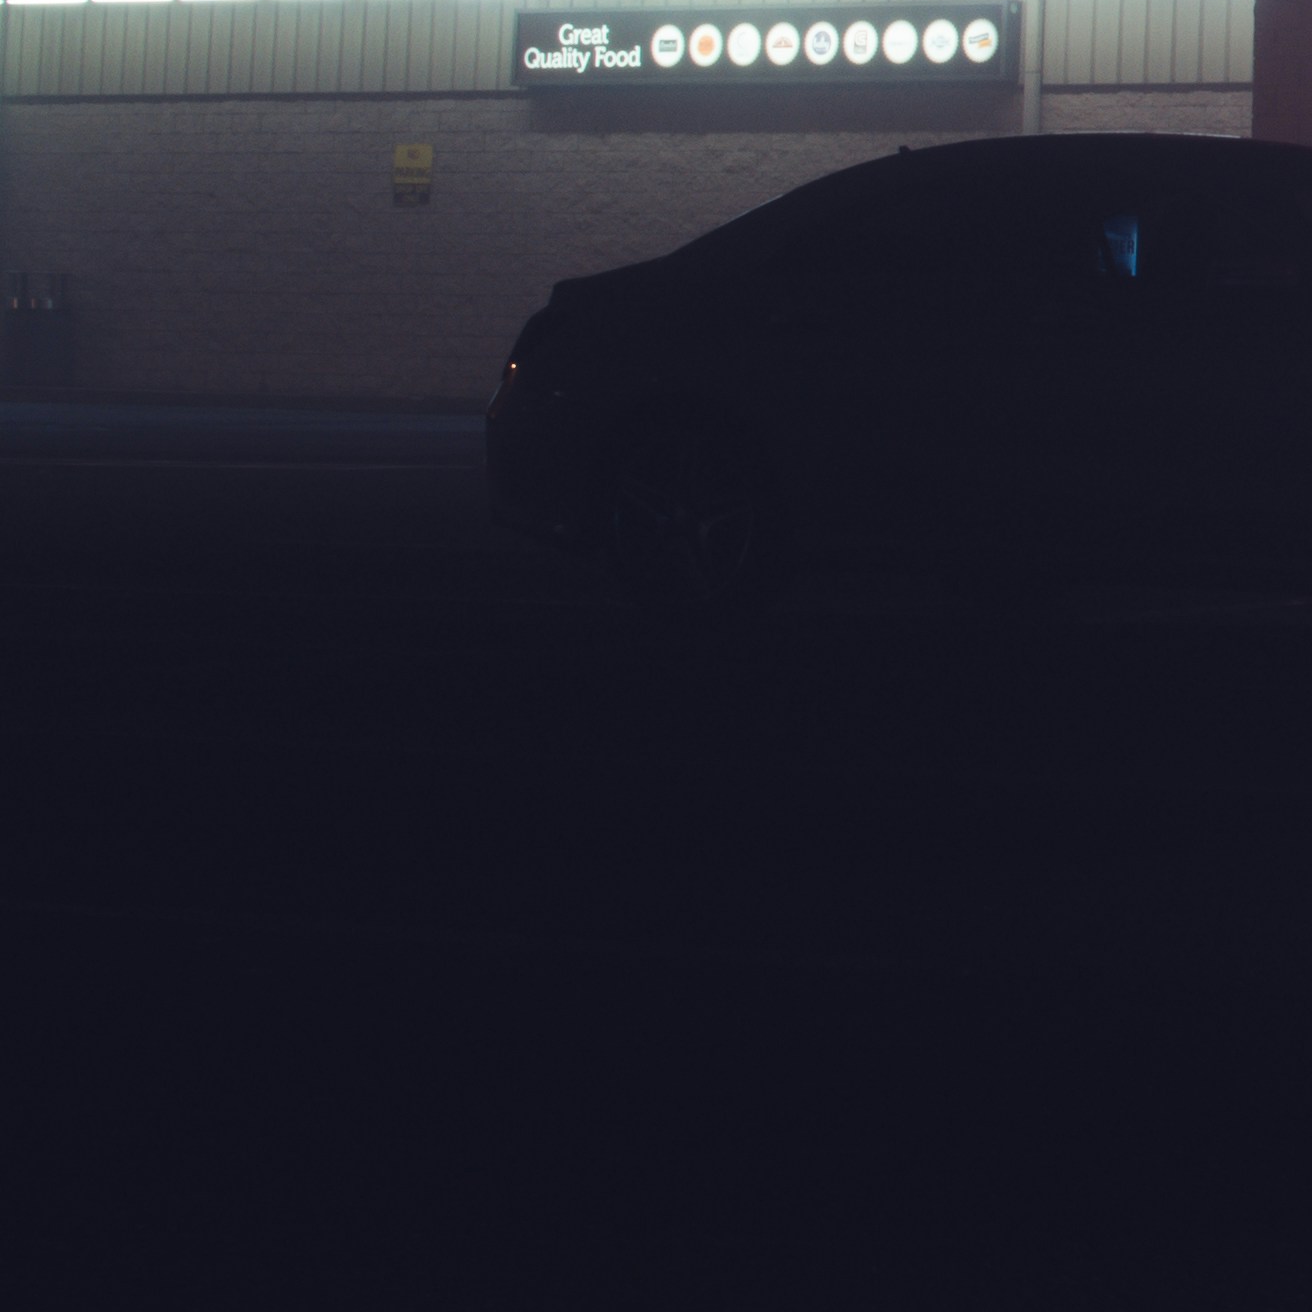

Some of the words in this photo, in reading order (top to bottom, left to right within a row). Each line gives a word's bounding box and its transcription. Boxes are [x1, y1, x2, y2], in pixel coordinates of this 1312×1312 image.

[558, 23, 610, 46] Great
[524, 46, 591, 73] Quality
[594, 45, 642, 68] Food
